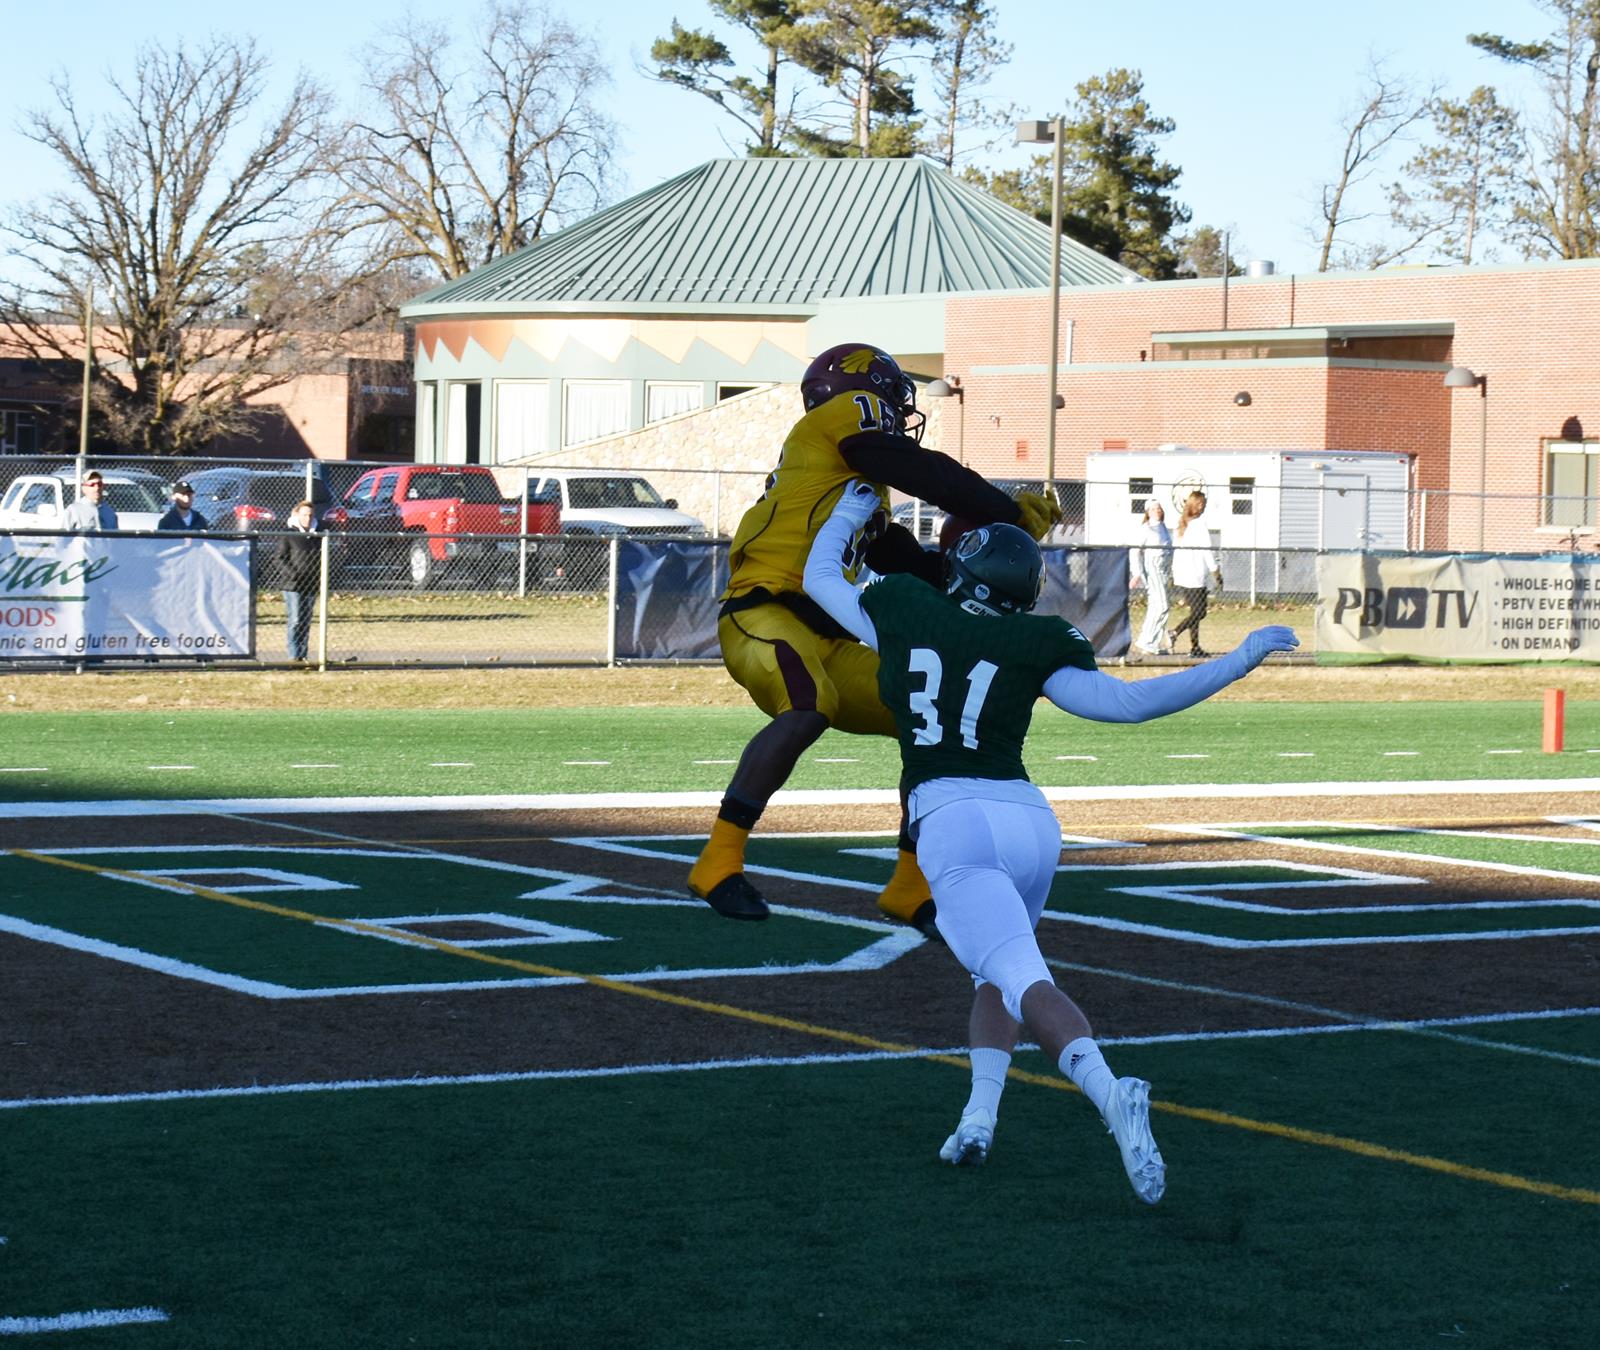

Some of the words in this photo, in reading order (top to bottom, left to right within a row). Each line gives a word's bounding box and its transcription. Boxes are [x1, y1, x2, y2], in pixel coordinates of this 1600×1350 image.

[1502, 598, 1535, 610] PBTV
[1502, 618, 1533, 630] HIGH
[33, 633, 68, 649] and
[74, 633, 128, 653] gluten
[135, 633, 170, 648] free
[176, 633, 231, 648] foods.
[1501, 637, 1519, 650] ON
[1524, 638, 1581, 651] DEMAND
[908, 648, 999, 750] 31
